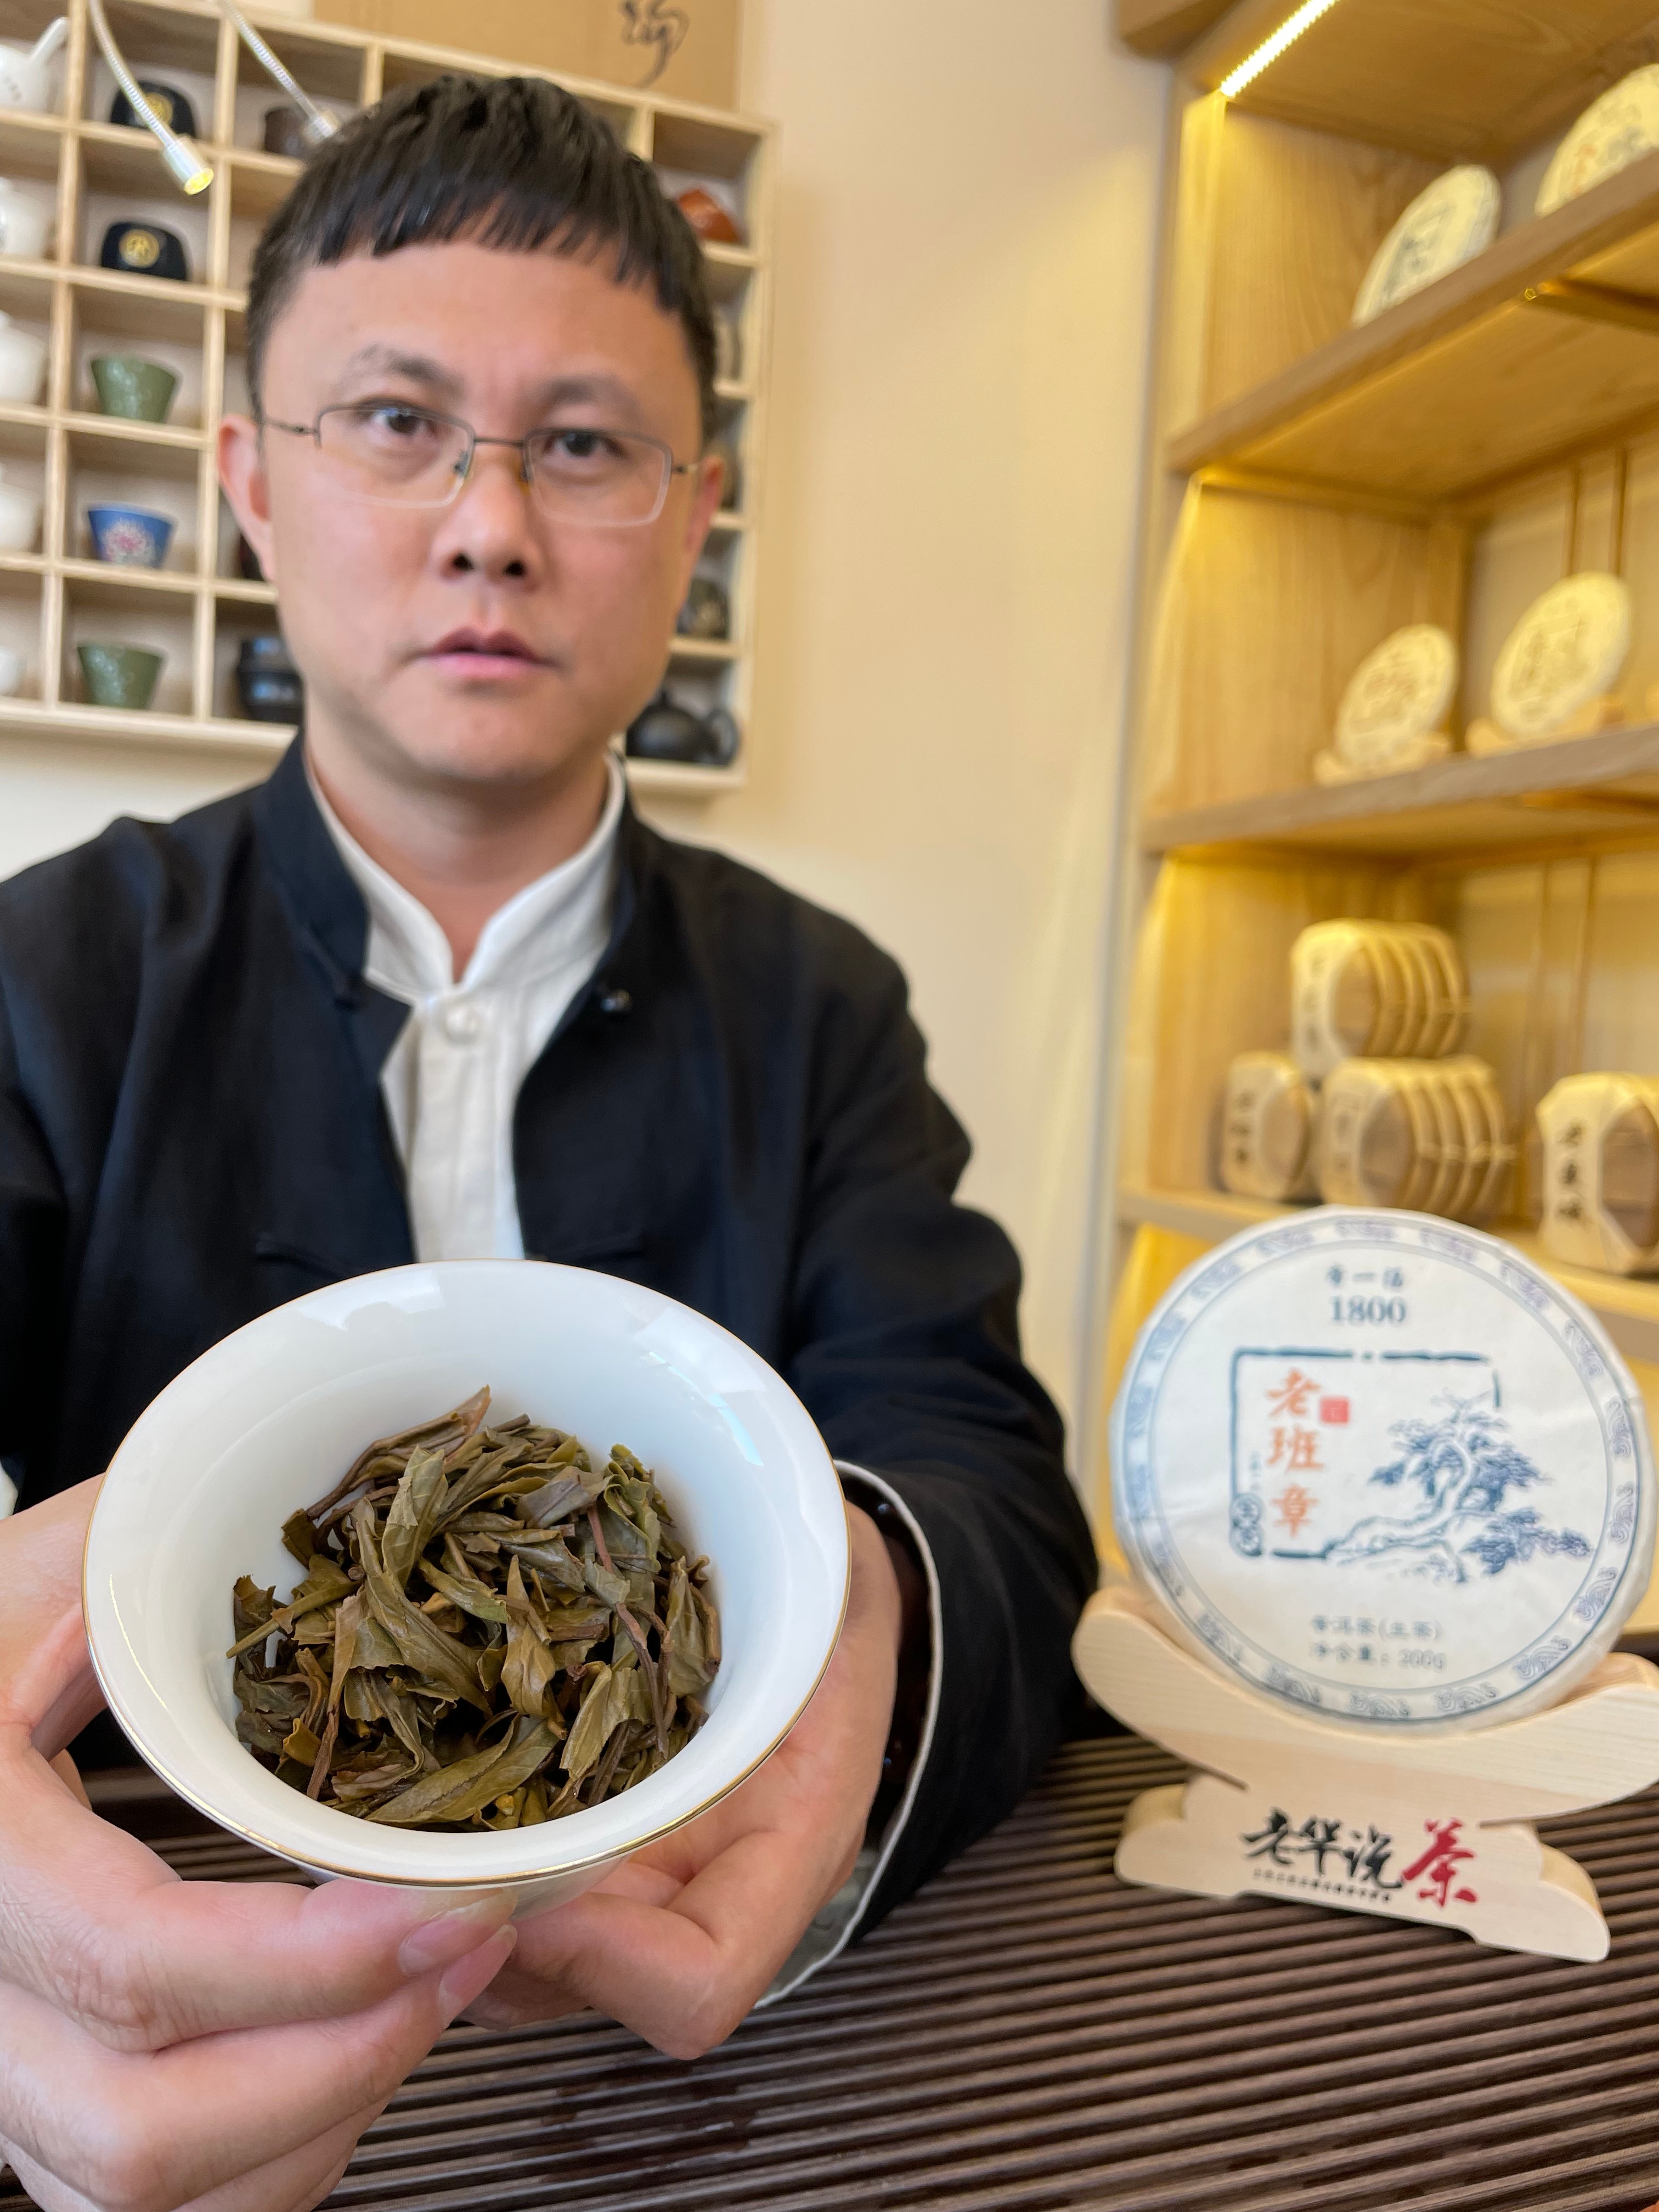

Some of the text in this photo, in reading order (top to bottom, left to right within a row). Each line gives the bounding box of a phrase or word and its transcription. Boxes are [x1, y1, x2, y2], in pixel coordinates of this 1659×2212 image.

[1330, 1295, 1407, 1326] 1800
[1266, 1367, 1324, 1537] 老班章
[1242, 1808, 1478, 1906] 老华说茶
